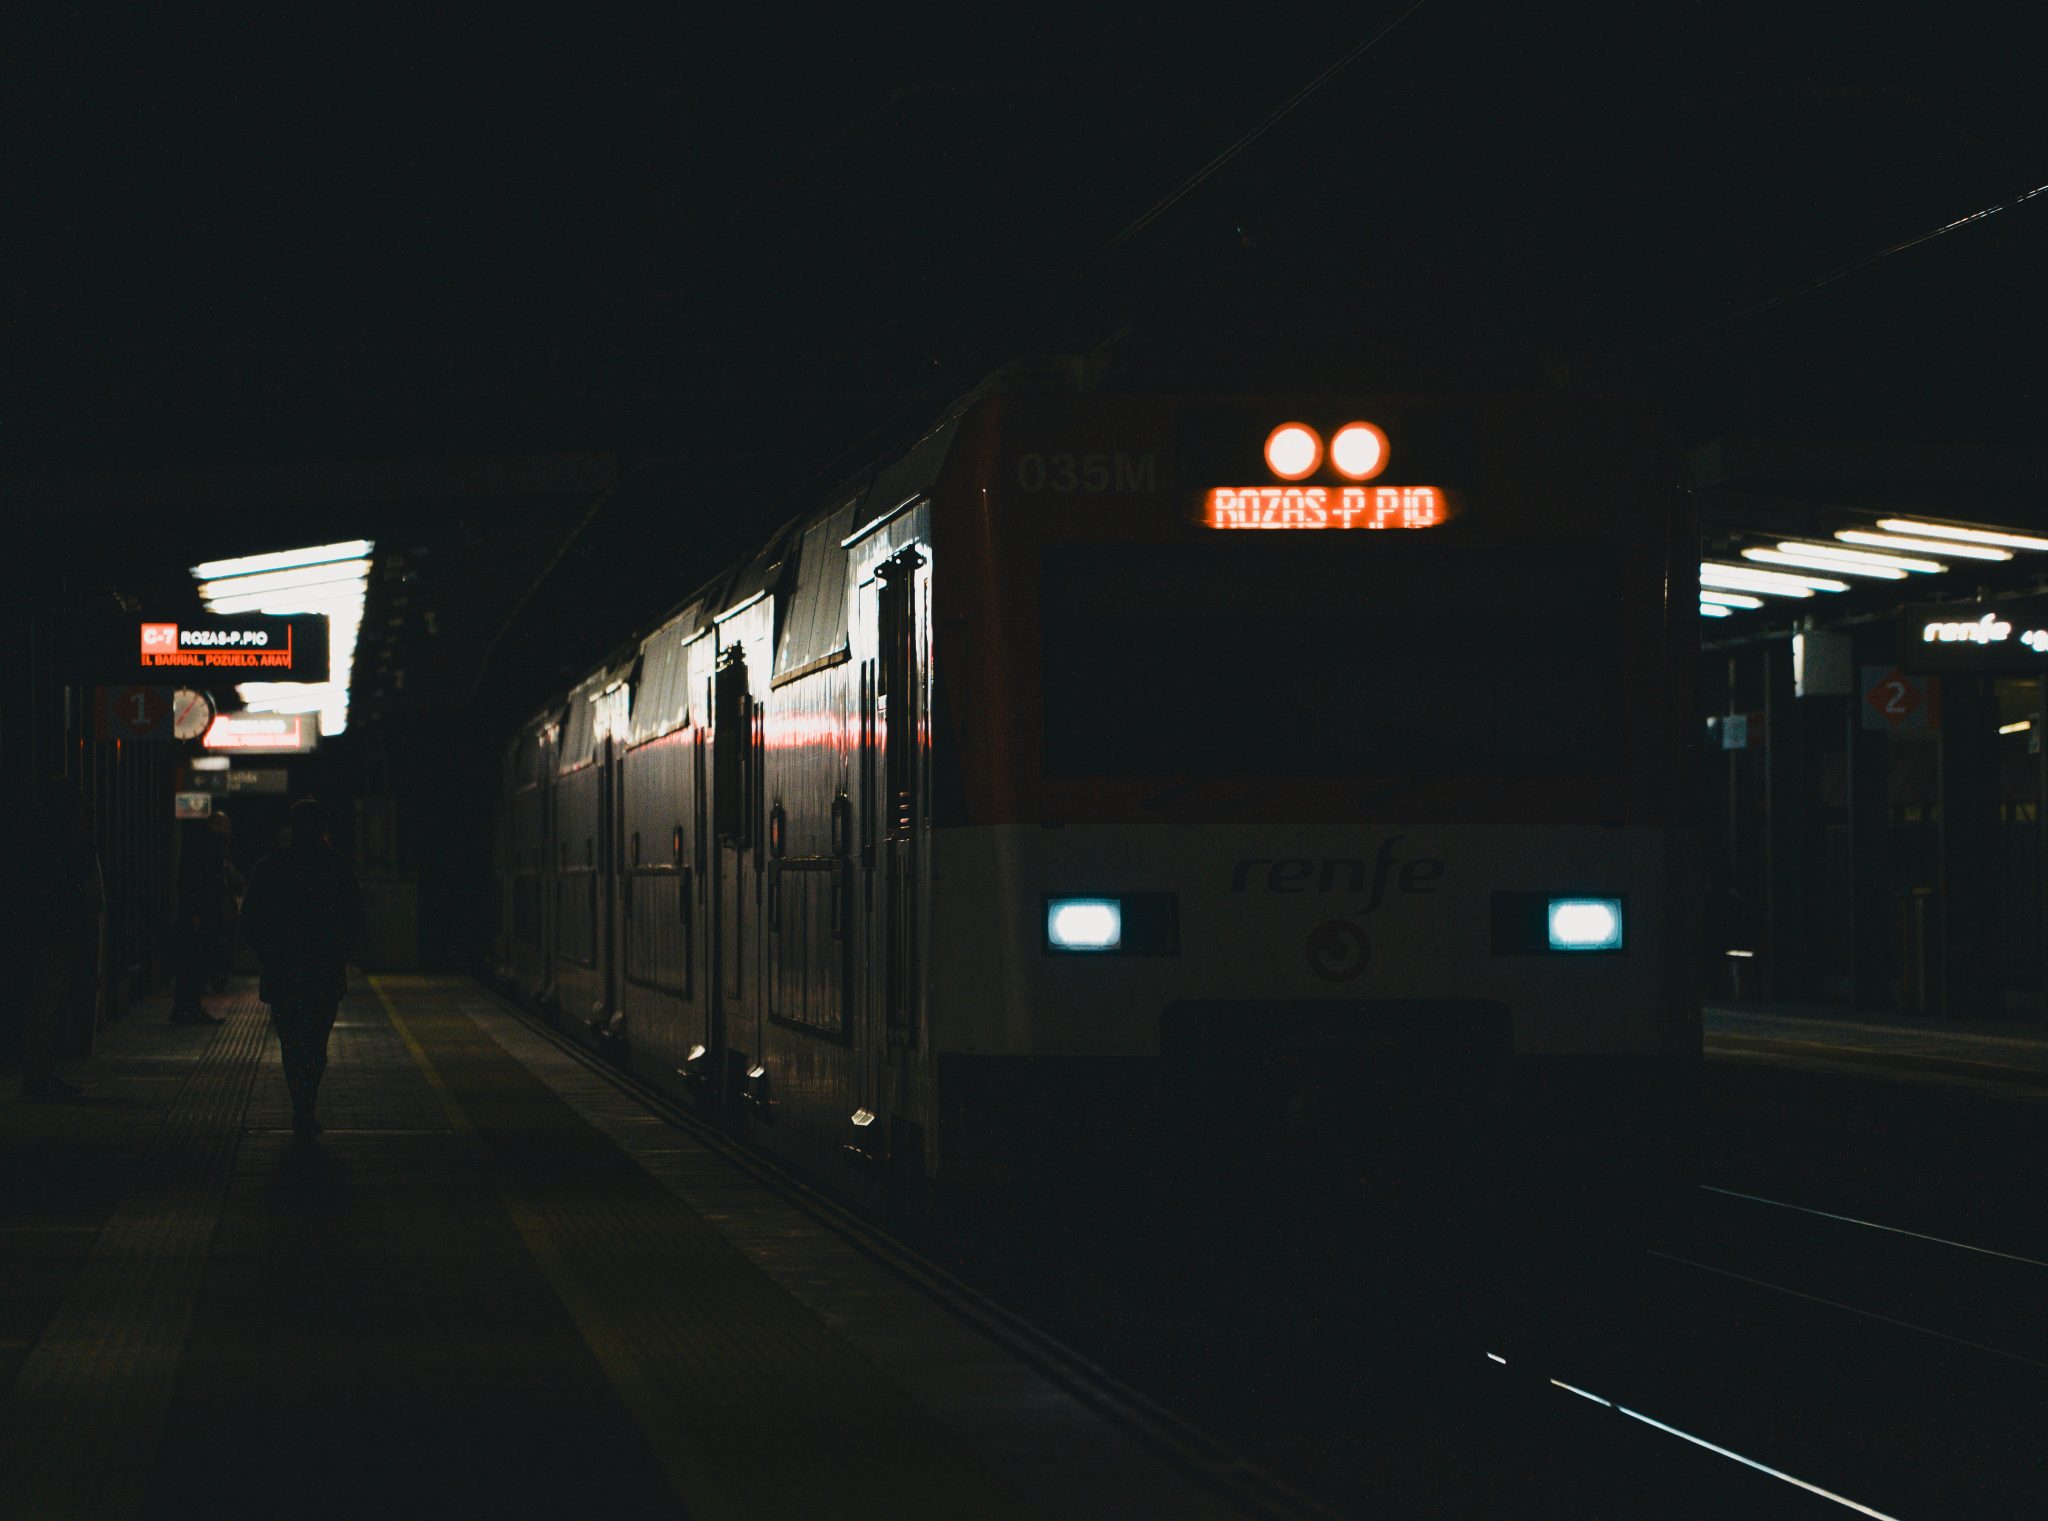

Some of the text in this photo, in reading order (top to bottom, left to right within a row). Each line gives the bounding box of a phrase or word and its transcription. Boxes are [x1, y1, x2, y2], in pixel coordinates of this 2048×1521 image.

[1016, 453, 1156, 492] 035M
[1213, 487, 1437, 529] ROZAS-P.PIO
[143, 628, 269, 646] C-7 ROZAS-P.PIO
[1923, 613, 2011, 645] renfe
[155, 654, 204, 668] BARRIAL,
[205, 654, 259, 668] POZUELO,
[129, 692, 152, 725] 1
[1885, 681, 1906, 713] 2
[1231, 835, 1445, 914] renfe
